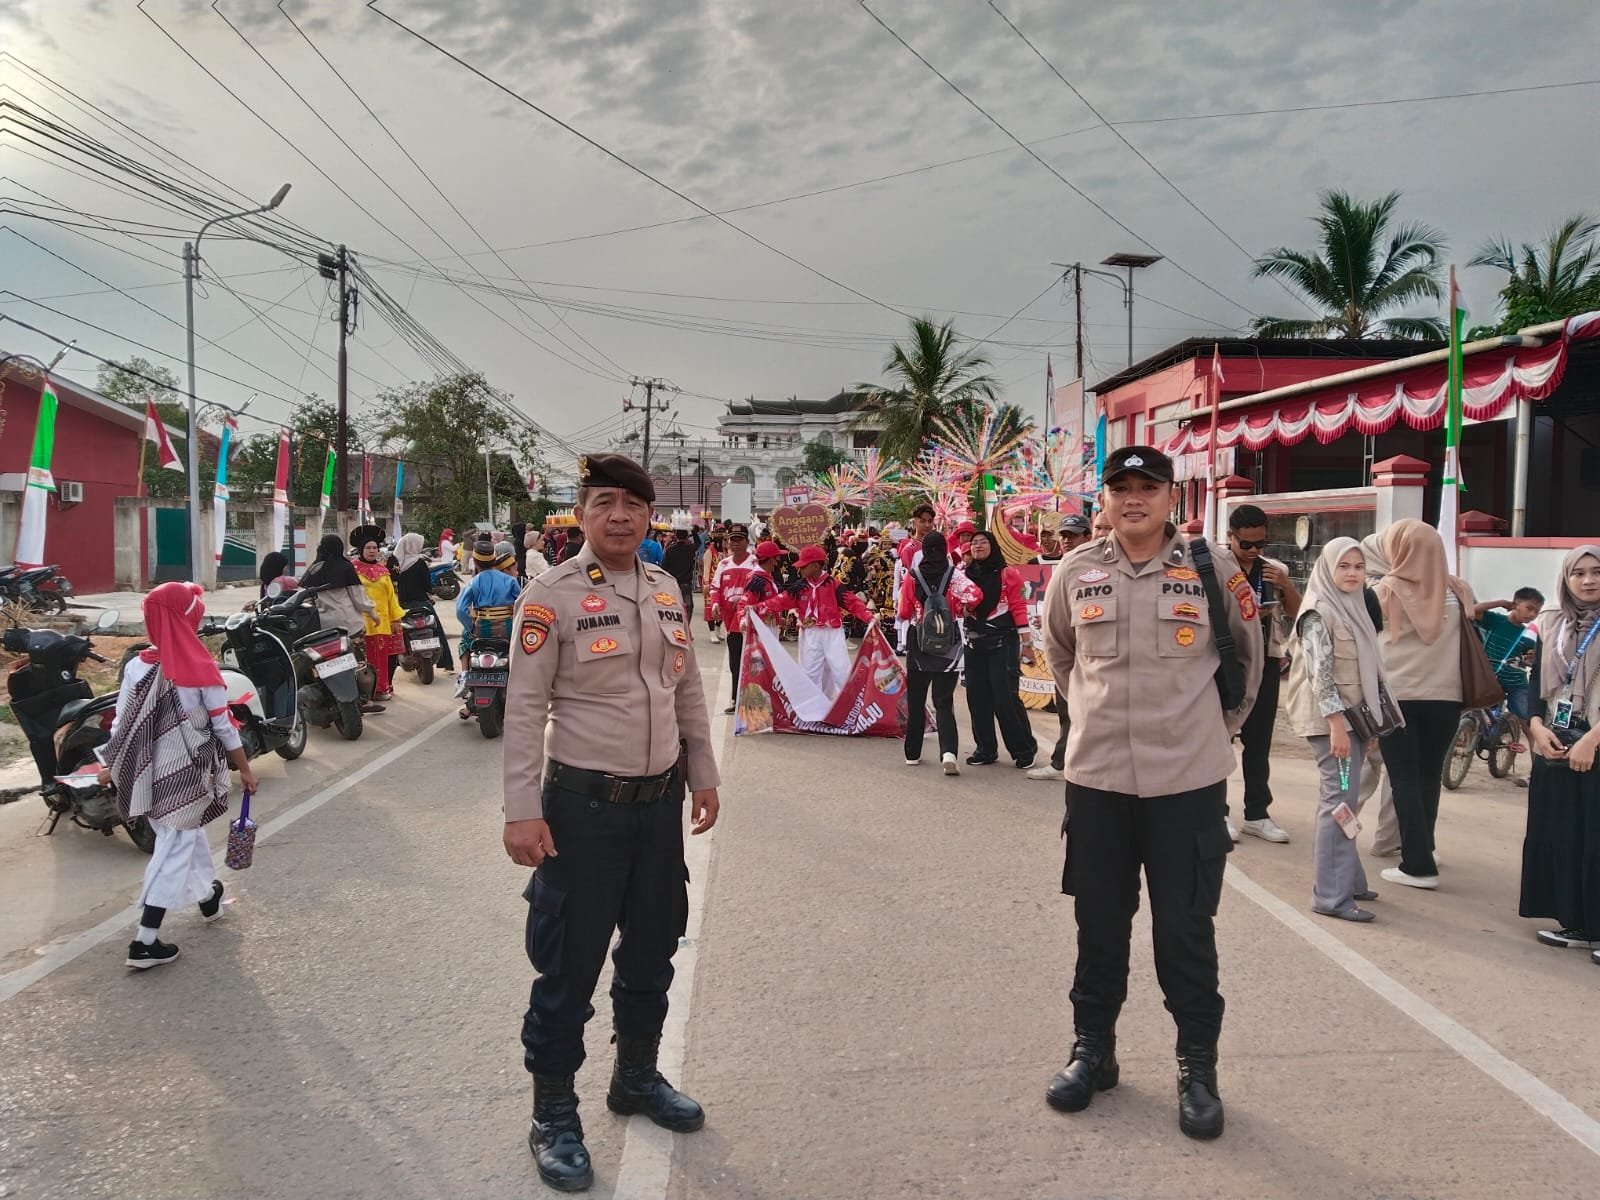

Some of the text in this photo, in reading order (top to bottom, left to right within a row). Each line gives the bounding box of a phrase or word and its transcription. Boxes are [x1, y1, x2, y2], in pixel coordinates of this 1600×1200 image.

[792, 496, 802, 504] 01
[777, 513, 825, 527] Anggana
[787, 524, 818, 534] selalu
[1075, 582, 1113, 601] ARYO
[1162, 582, 1206, 599] POLRI
[575, 613, 621, 632] JUMARIN
